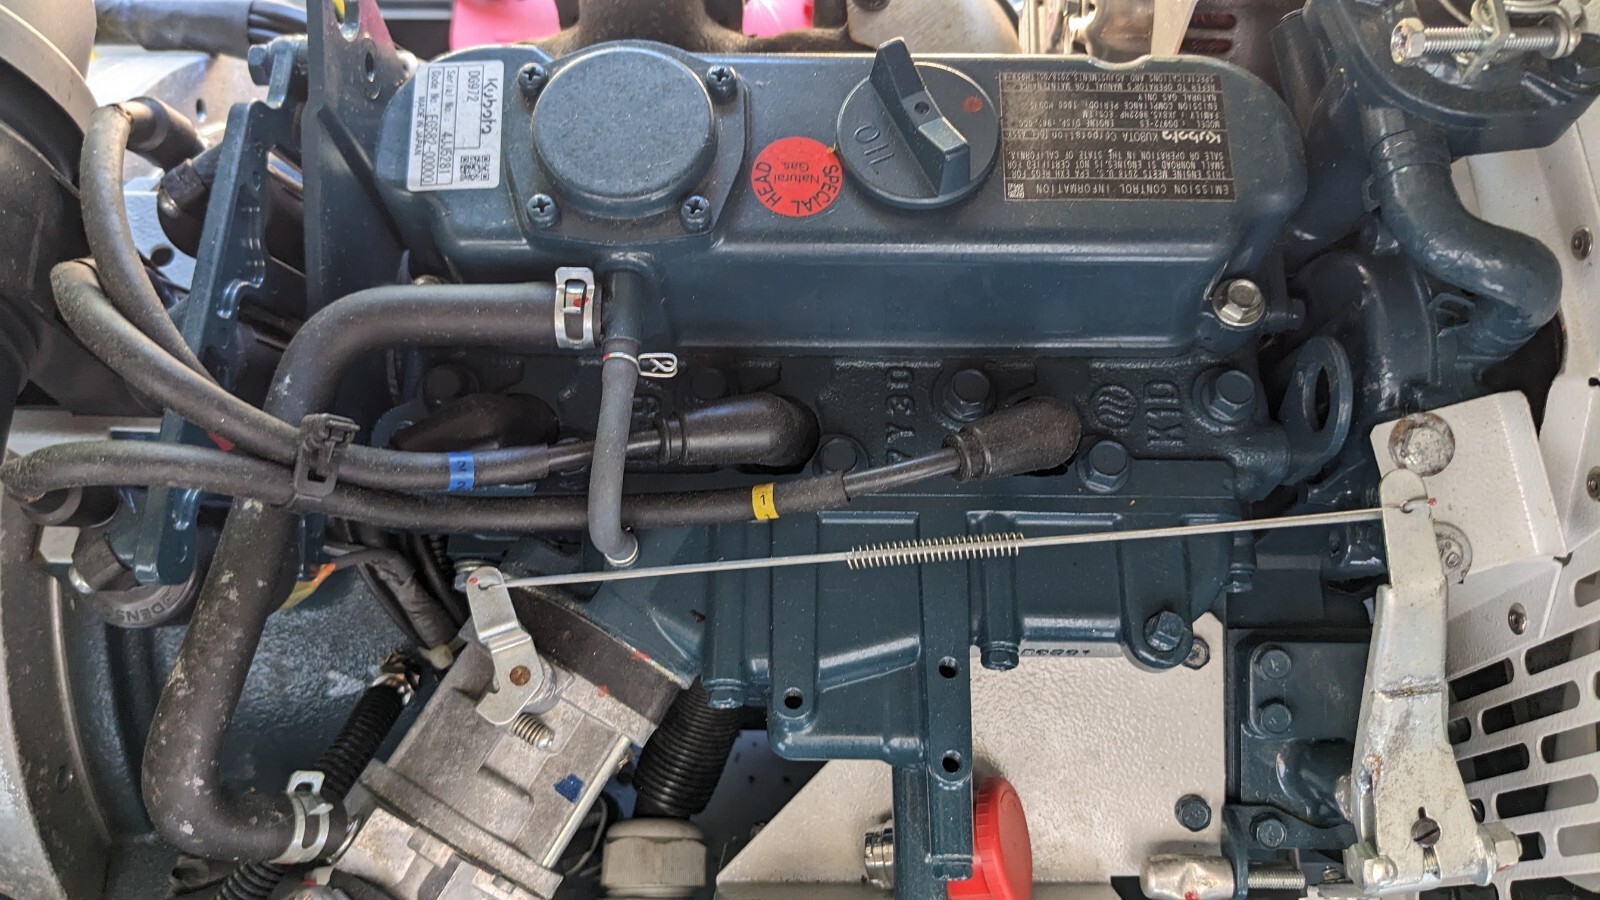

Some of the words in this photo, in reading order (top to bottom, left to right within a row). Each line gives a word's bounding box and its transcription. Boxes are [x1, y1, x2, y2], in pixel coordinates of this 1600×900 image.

[431, 70, 441, 90] Code
[445, 69, 455, 98] Serial
[467, 70, 480, 102] DG972
[1138, 93, 1157, 101] ONLY
[1162, 93, 1177, 101] GAS
[1182, 93, 1217, 102] NATURAL
[417, 96, 425, 118] MADE
[481, 78, 498, 135] Kubota
[416, 120, 424, 128] IN
[1051, 130, 1117, 142] Corporation
[1122, 132, 1158, 142] KUBOTA
[1161, 131, 1221, 144] Kubota
[414, 130, 423, 156] JAPAN
[1078, 151, 1102, 159] STATE
[1108, 151, 1121, 159] THE
[1141, 151, 1185, 160] OPERATION
[1189, 151, 1200, 160] OR
[1204, 152, 1224, 160] SALE
[1007, 160, 1022, 168] FOR
[774, 174, 820, 184] Natural
[1011, 169, 1026, 178] FOR
[754, 161, 782, 207] HEAD
[791, 164, 839, 215] SPECIAL
[1036, 183, 1110, 194] INFORMATION
[1119, 184, 1167, 194] CONTROL
[1173, 184, 1229, 195] EMISSION
[457, 460, 467, 472] 2
[759, 494, 766, 506] 1
[106, 602, 166, 622] DENS
